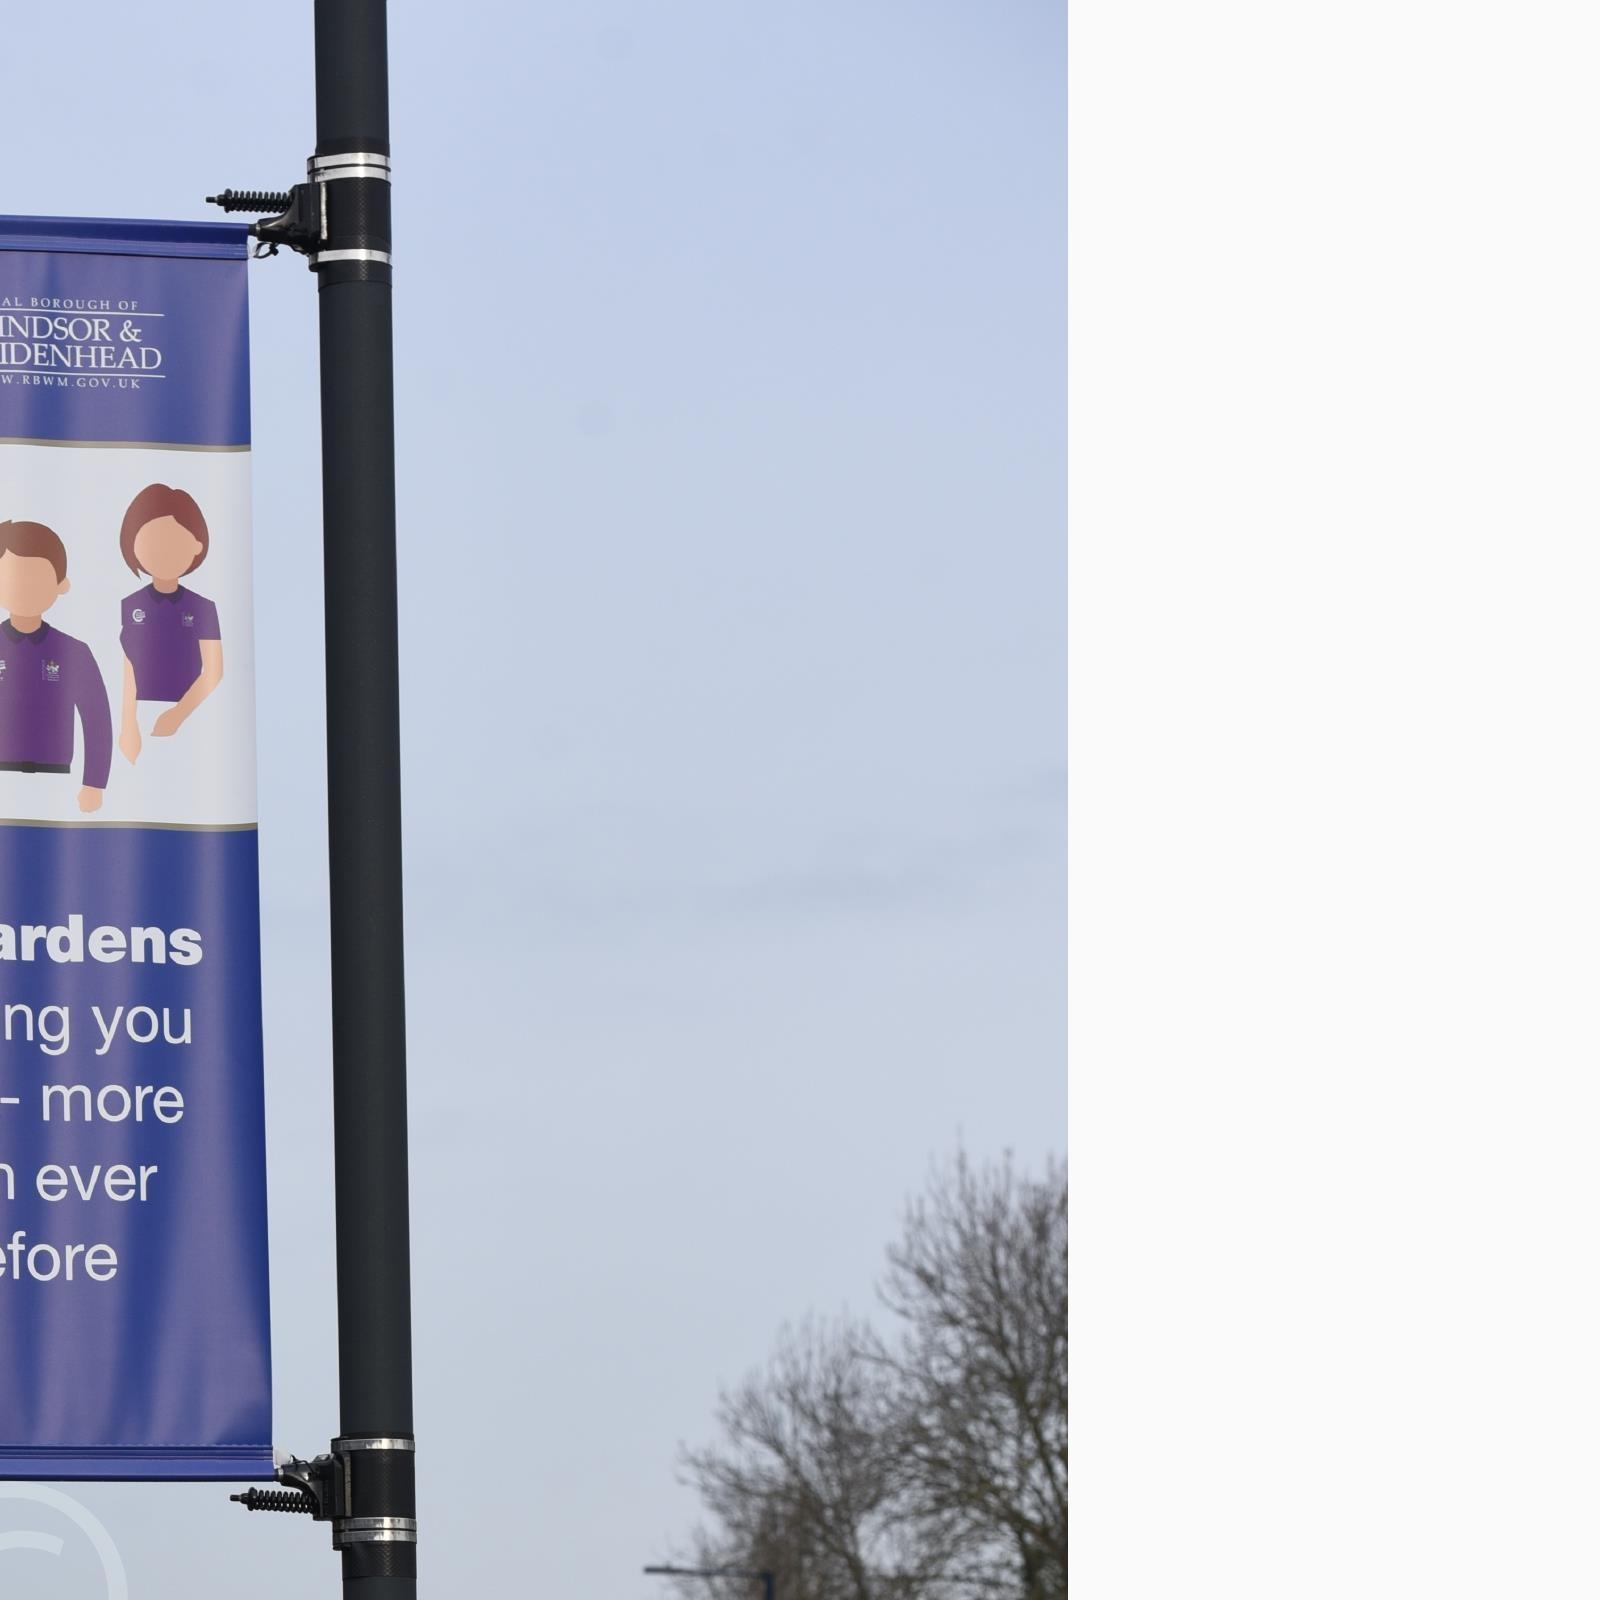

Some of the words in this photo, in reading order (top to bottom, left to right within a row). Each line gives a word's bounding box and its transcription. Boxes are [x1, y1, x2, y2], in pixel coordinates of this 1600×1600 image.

[30, 297, 111, 311] BOROUGH
[117, 301, 139, 311] OF
[119, 319, 143, 343] &
[91, 1006, 192, 1056] you
[42, 1083, 185, 1124] more
[36, 1164, 158, 1202] ever
